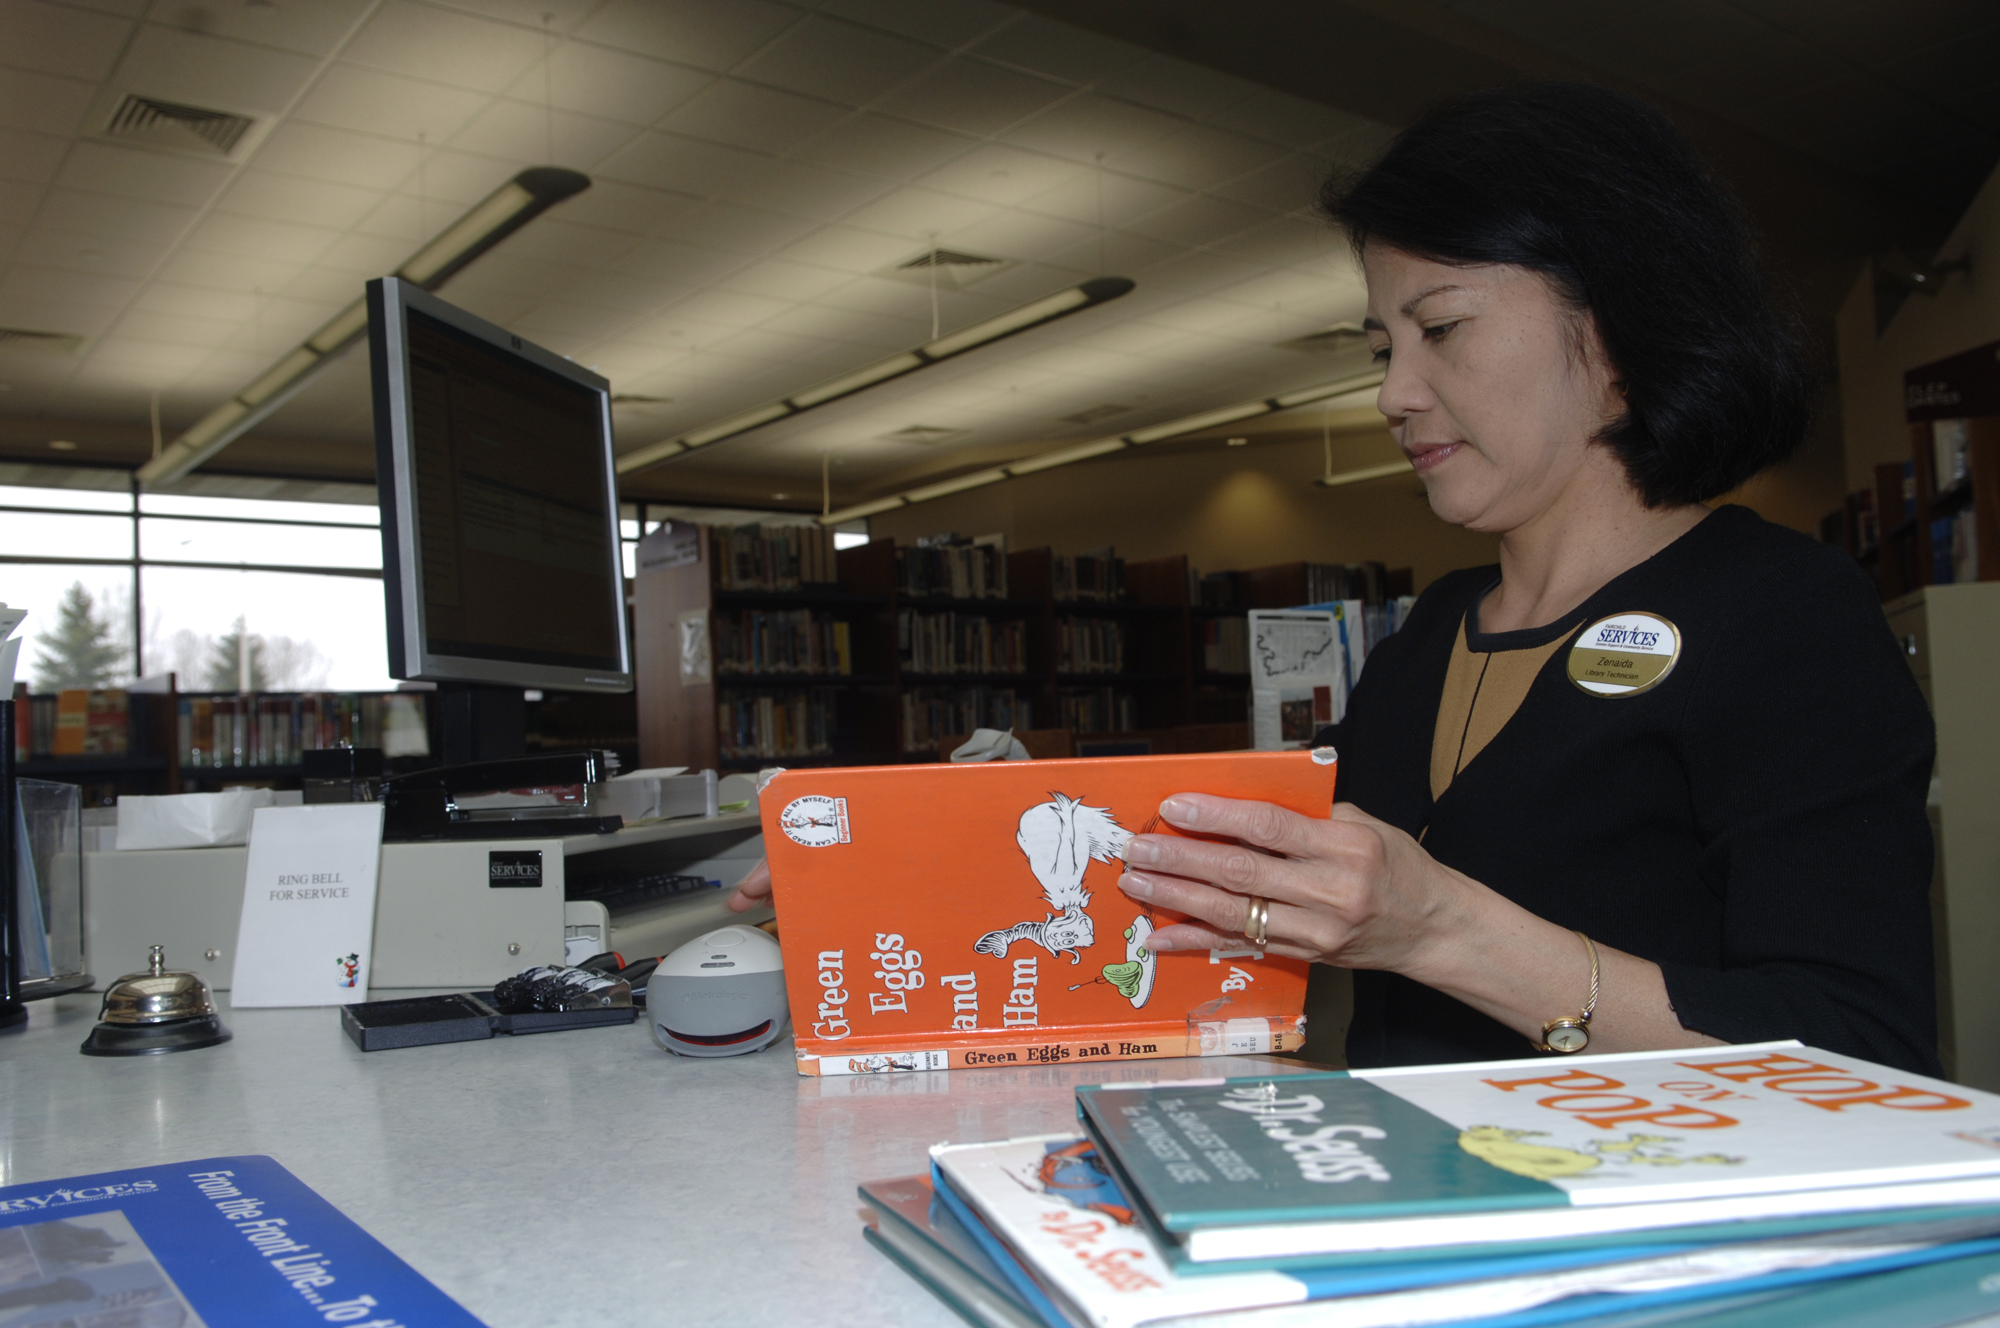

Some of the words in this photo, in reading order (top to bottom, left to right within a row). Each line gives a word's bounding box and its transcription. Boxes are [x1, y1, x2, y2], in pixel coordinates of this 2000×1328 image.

[1597, 628, 1659, 646] SERVICES
[1597, 656, 1633, 668] Zenaida
[1585, 669, 1605, 677] Library
[1607, 670, 1638, 680] Technician
[791, 800, 801, 808] BY
[802, 796, 832, 805] MYSELF
[836, 799, 845, 817] Books
[783, 808, 793, 818] ALL
[792, 835, 812, 846] READ
[840, 817, 849, 842] Beginner
[278, 874, 309, 886] RING
[311, 872, 343, 885] BELL
[490, 864, 540, 877] SERVICES
[269, 889, 294, 901] FOR
[296, 887, 350, 900] SERVICE
[868, 932, 925, 1016] Eggs
[1221, 966, 1254, 994] By
[811, 949, 852, 1041] Green
[940, 971, 980, 1031] and
[1002, 956, 1039, 1028] Ham
[964, 1051, 1018, 1065] Green
[1026, 1044, 1070, 1062] Eggs
[1078, 1043, 1111, 1057] and
[1118, 1042, 1158, 1056] Ham
[1274, 1034, 1282, 1050] B-16
[1657, 1080, 1761, 1103] ON
[1672, 1053, 1974, 1112] HOP
[1217, 1094, 1324, 1128] Dr.
[1482, 1069, 1740, 1130] POP
[1264, 1124, 1391, 1183] Seuss
[188, 1170, 242, 1199] From
[215, 1198, 265, 1220] the
[235, 1217, 310, 1256] Front
[1075, 1248, 1163, 1293] Seuss
[317, 1294, 378, 1321] To
